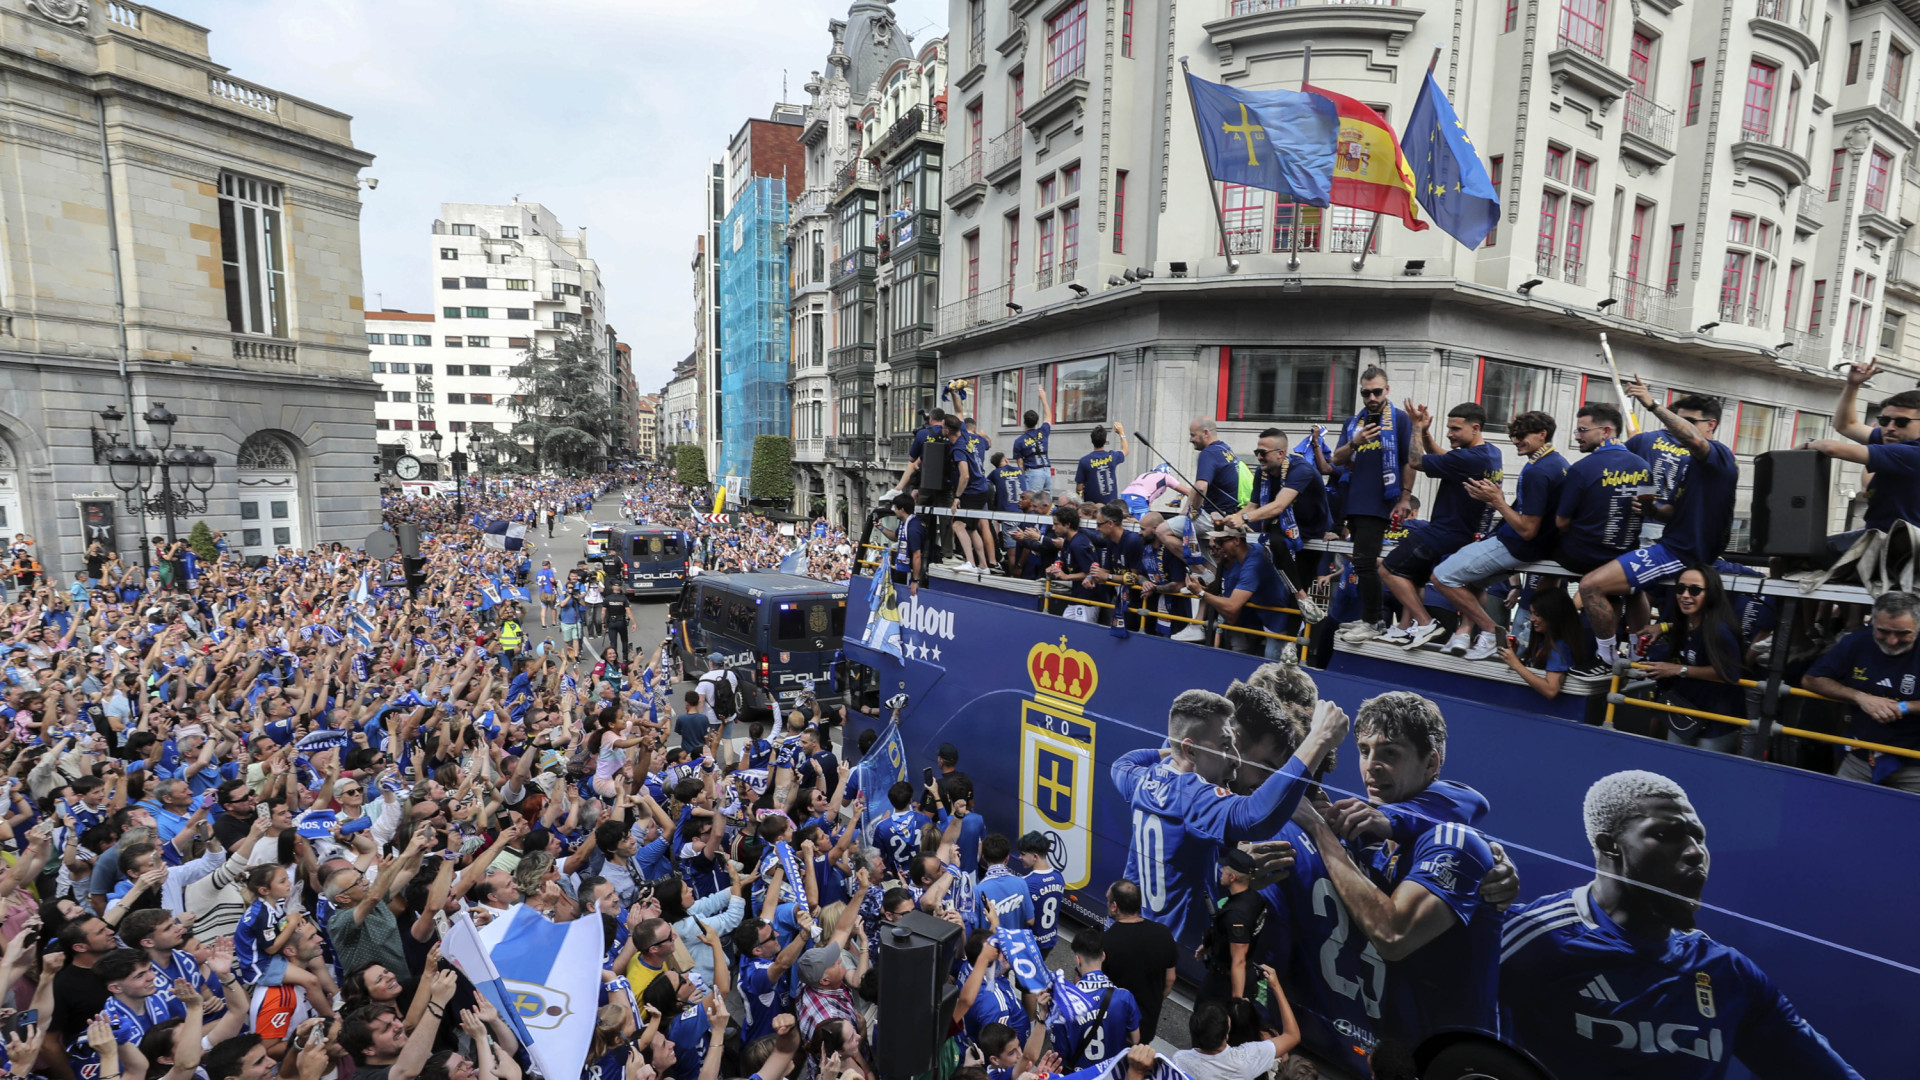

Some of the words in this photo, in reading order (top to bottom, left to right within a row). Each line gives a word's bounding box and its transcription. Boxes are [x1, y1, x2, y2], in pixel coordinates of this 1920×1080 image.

[897, 594, 955, 641] ahou
[1133, 808, 1166, 913] 10
[1041, 896, 1058, 929] 8
[1083, 1025, 1105, 1061] 8
[1575, 1012, 1723, 1063] DIGI
